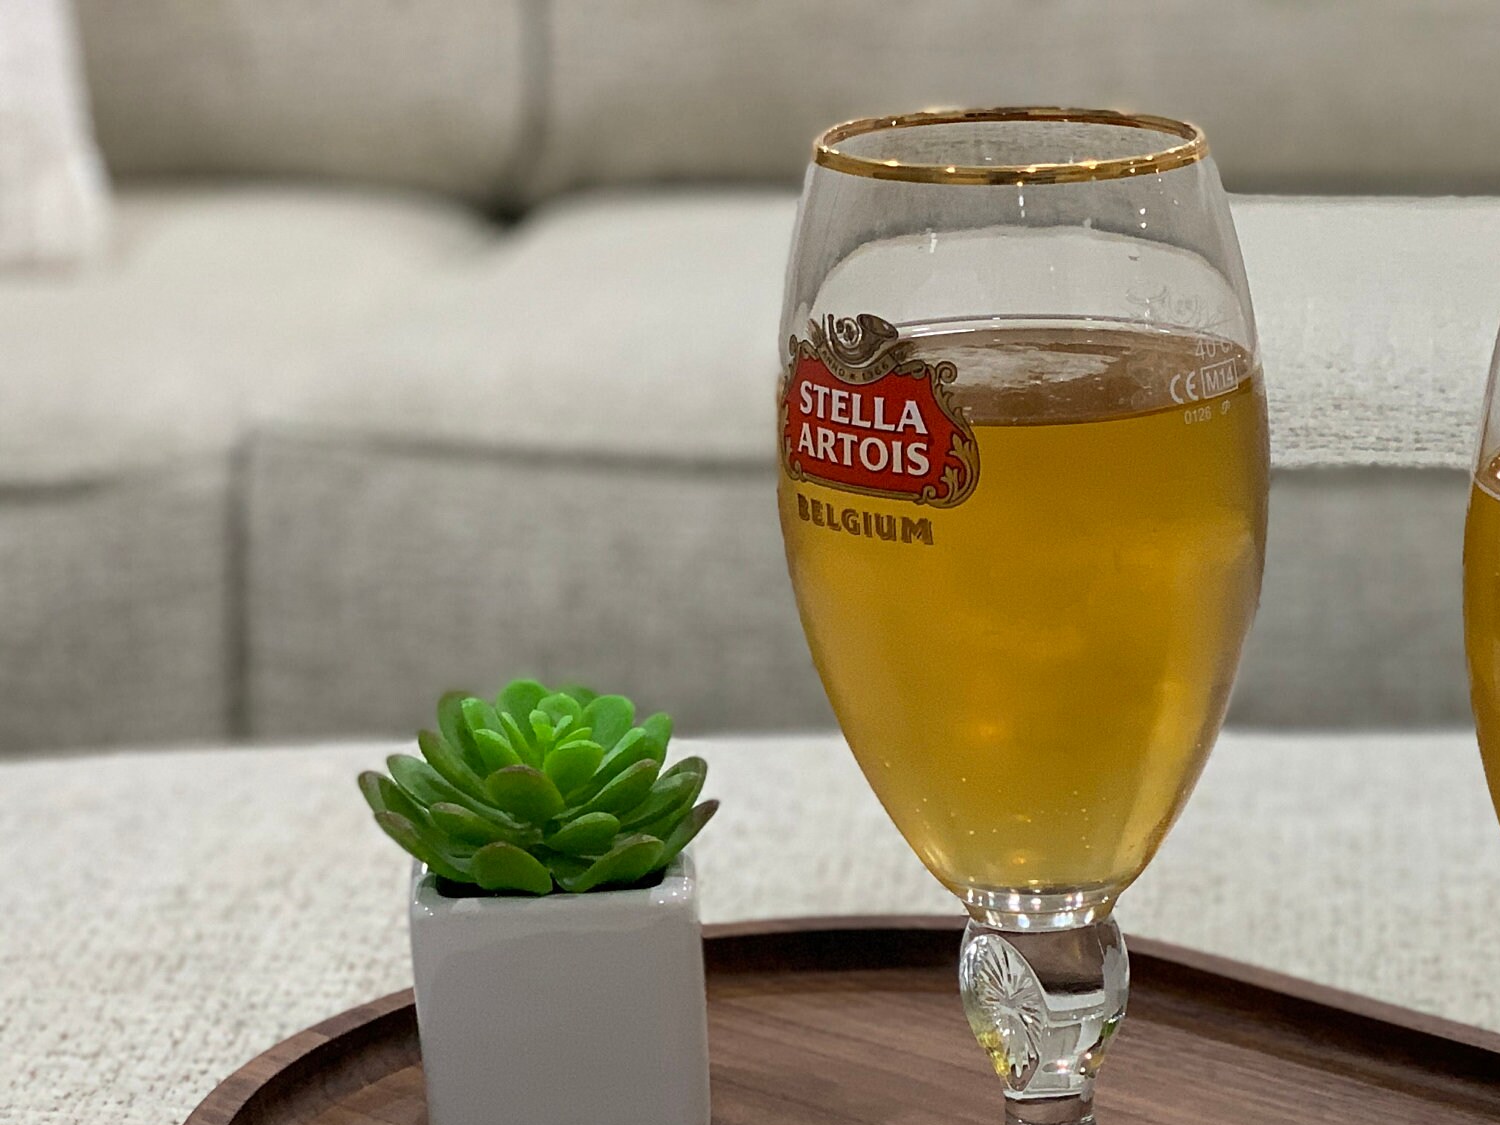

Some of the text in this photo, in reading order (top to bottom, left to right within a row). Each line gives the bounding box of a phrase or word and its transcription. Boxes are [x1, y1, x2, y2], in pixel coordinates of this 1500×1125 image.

[800, 380, 928, 434] STELLA
[1169, 365, 1235, 404] CE M14
[1184, 406, 1212, 424] 0126
[798, 422, 930, 476] ARTOIS
[797, 493, 934, 545] BELGIUM
